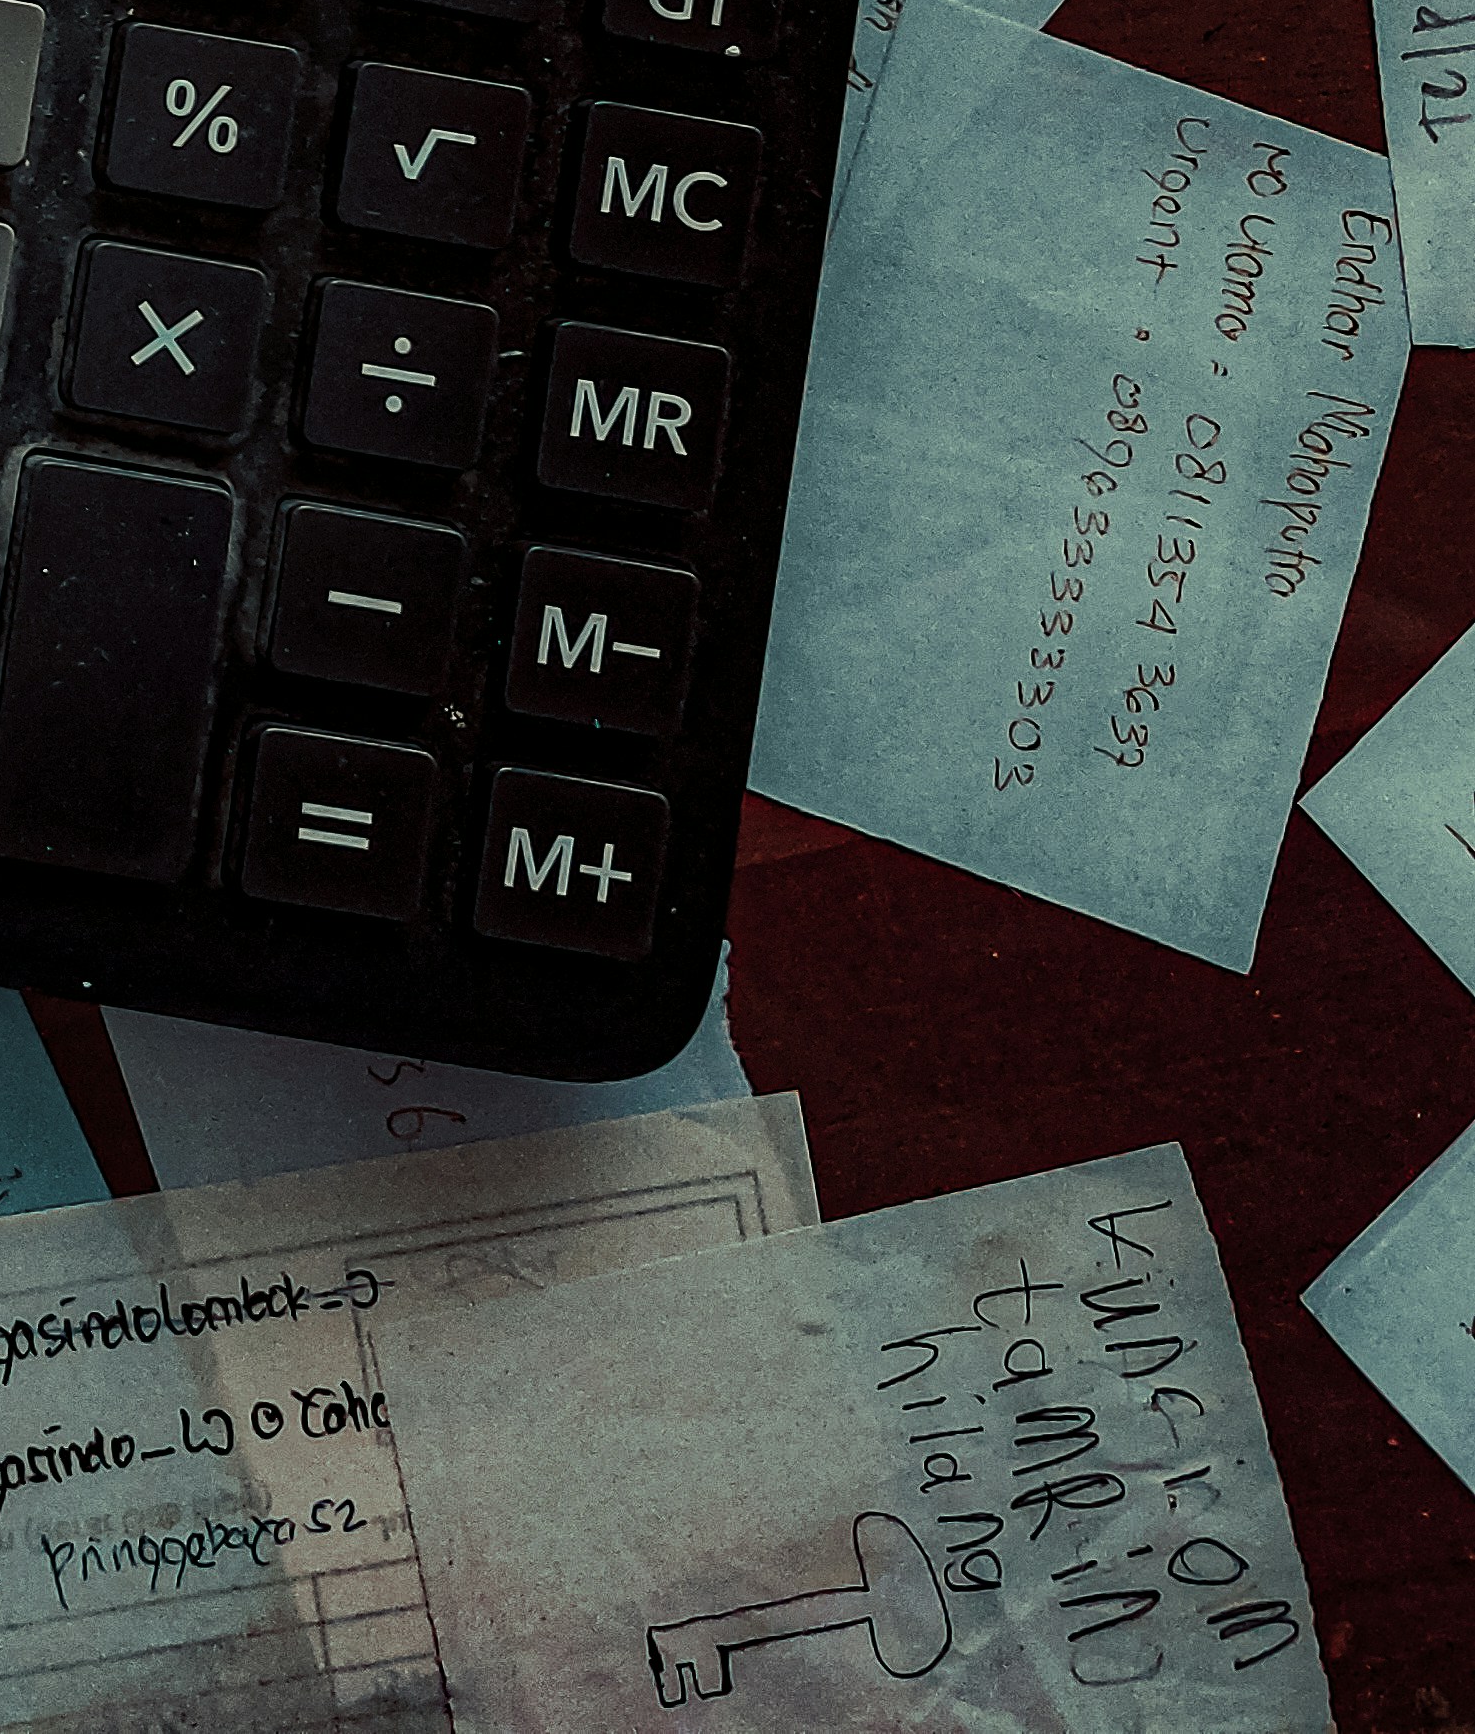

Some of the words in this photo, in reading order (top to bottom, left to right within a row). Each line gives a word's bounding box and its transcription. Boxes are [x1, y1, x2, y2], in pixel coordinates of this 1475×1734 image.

[167, 80, 237, 153] %
[601, 156, 727, 231] MC
[570, 379, 691, 455] MR
[504, 827, 632, 903] M+
